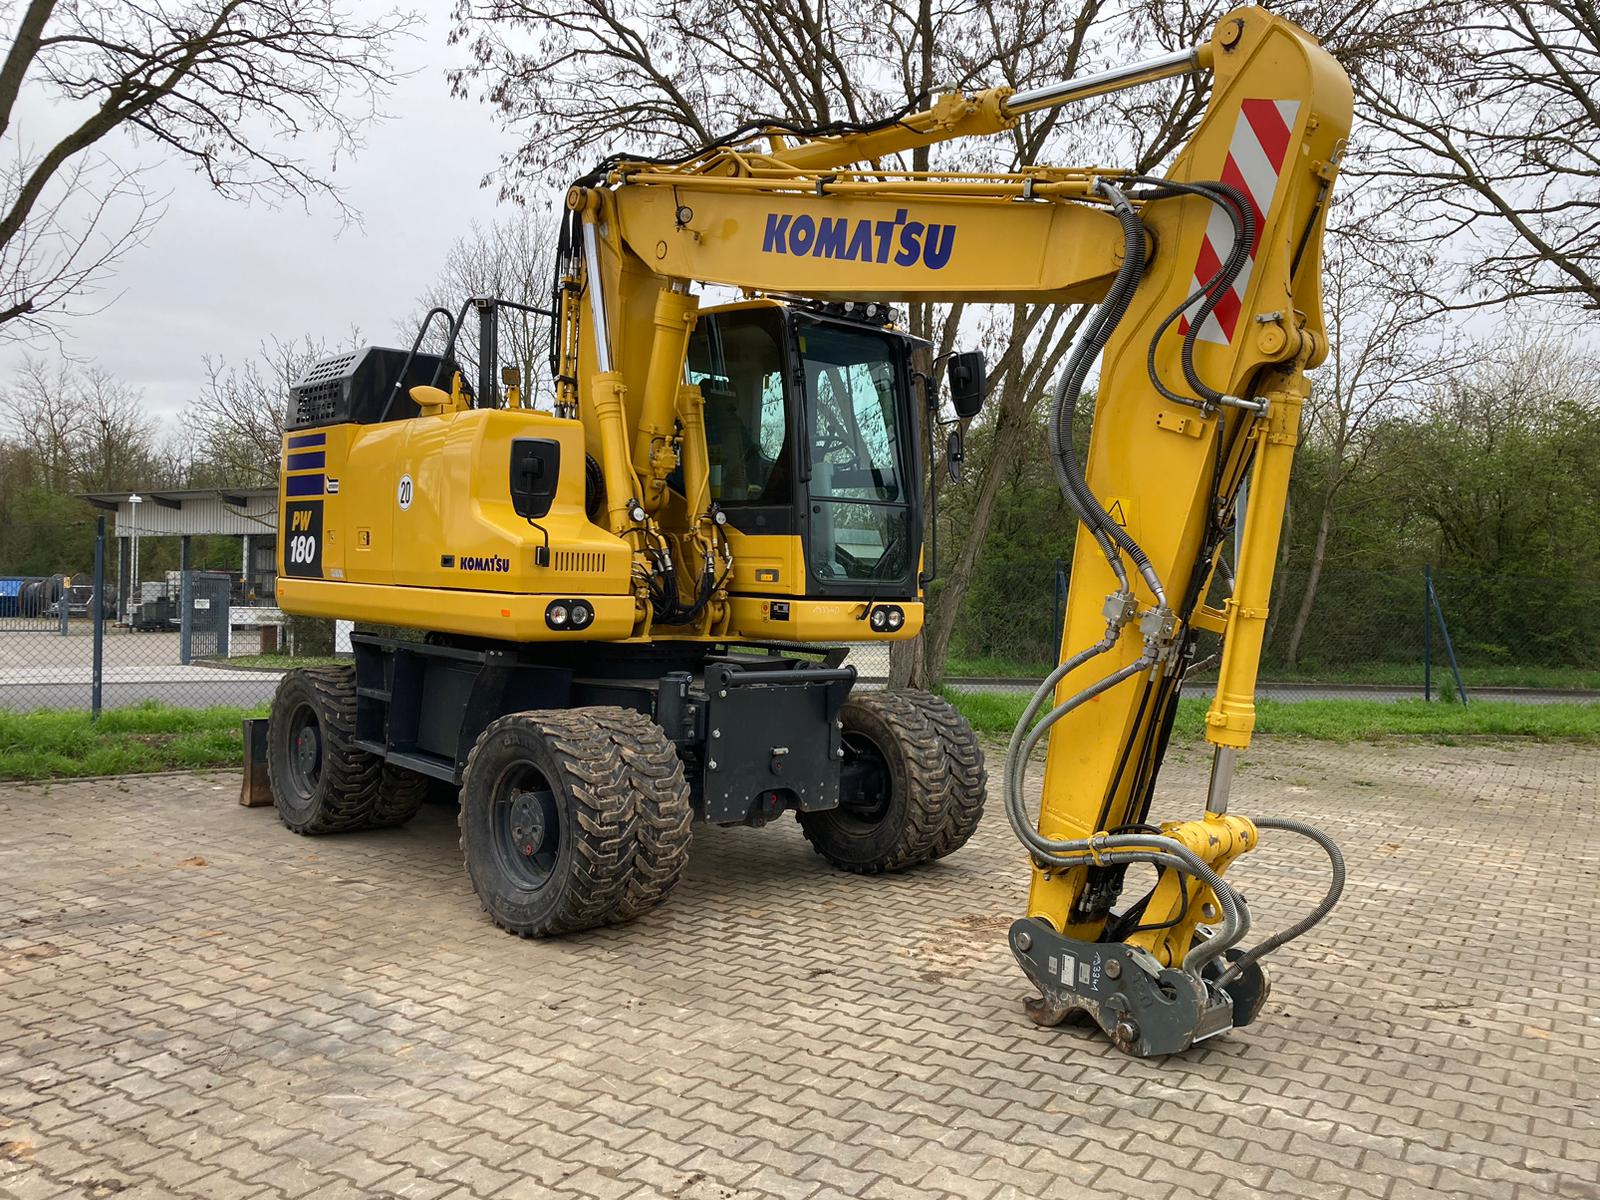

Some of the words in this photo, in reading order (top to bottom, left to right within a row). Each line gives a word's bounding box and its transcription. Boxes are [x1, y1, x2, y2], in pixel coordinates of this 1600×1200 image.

[762, 208, 957, 270] KOMATSU
[400, 481, 411, 504] 20
[291, 510, 312, 531] PW
[290, 535, 316, 564] 180
[460, 554, 510, 573] KOMATSU
